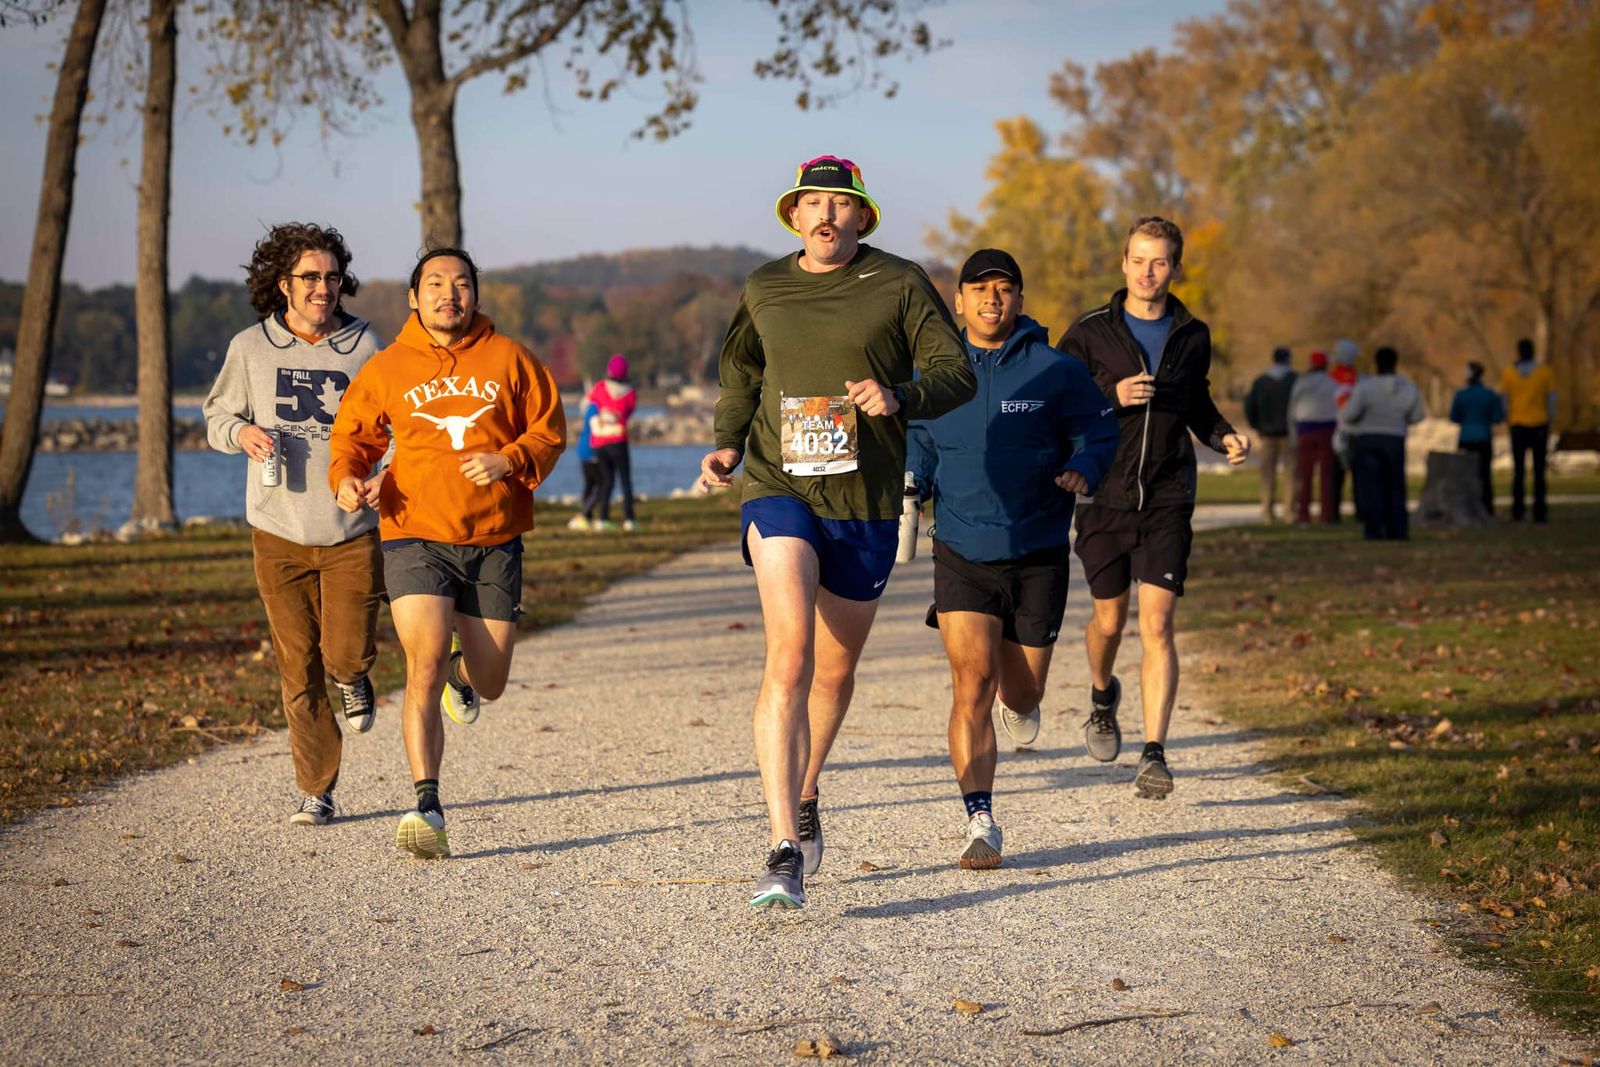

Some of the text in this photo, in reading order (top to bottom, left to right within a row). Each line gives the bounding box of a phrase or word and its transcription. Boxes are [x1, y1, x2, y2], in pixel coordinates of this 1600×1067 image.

[292, 370, 312, 380] FALL
[403, 376, 500, 409] TEXAS
[1001, 403, 1029, 412] ECFP
[274, 423, 317, 433] SCENIC
[802, 420, 834, 430] TEAM
[279, 431, 331, 441] PIC FU
[790, 431, 849, 455] 4032
